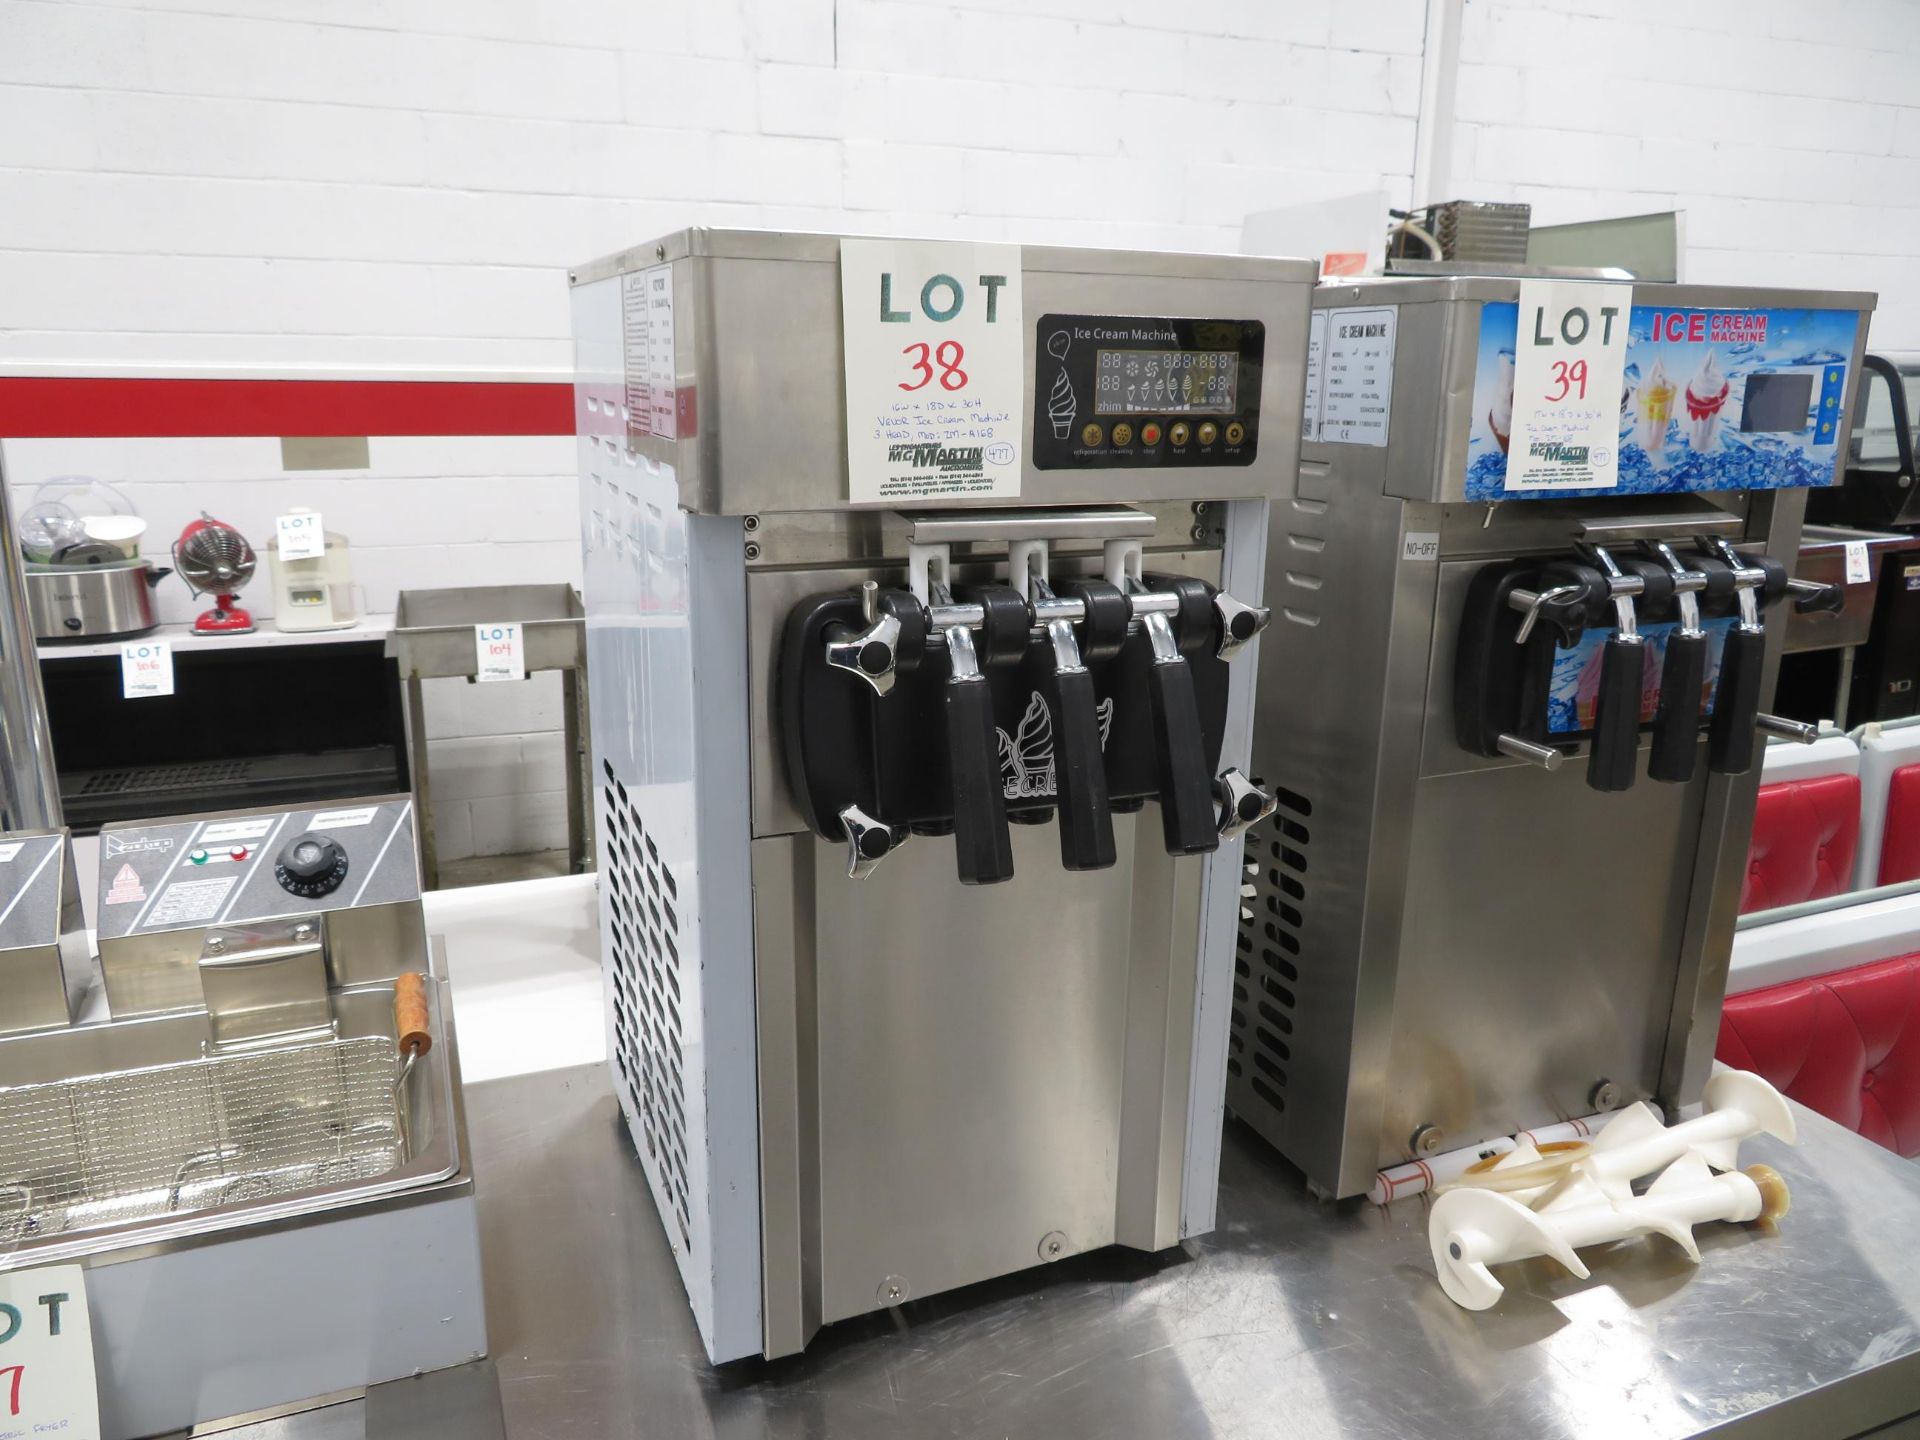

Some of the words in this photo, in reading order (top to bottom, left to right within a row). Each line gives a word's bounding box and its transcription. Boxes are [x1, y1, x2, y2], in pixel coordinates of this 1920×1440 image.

[880, 273, 1007, 323] LOT
[1534, 306, 1619, 346] LOT
[1651, 313, 1706, 343] ICE
[1711, 315, 1767, 330] CREAM
[1074, 328, 1091, 339] Ice
[1093, 328, 1129, 340] Cream
[1131, 329, 1177, 341] Machine
[1711, 331, 1766, 343] MACHINE
[898, 340, 968, 391] 38
[1544, 359, 1588, 402] 39
[912, 446, 984, 468] MARTIN
[1544, 446, 1590, 462] MARTIN
[879, 485, 993, 496] www.mgmartin.com
[281, 517, 313, 530] LOT
[480, 628, 514, 641] LOT
[127, 646, 161, 659] LOT
[490, 643, 512, 656] 104
[0, 1293, 69, 1345] OT
